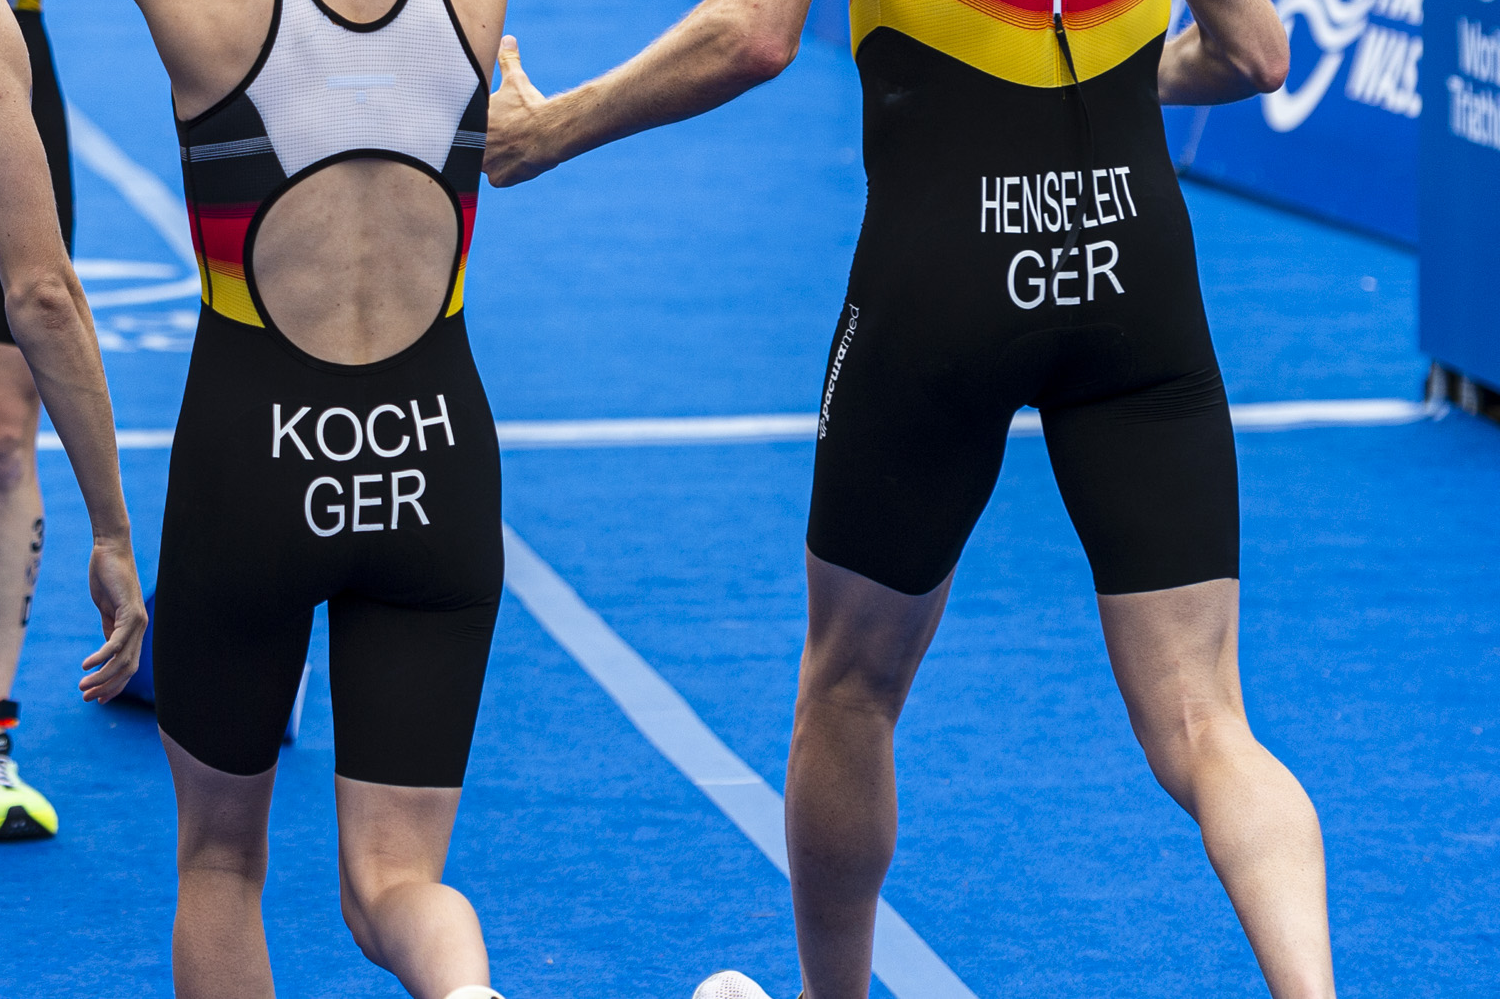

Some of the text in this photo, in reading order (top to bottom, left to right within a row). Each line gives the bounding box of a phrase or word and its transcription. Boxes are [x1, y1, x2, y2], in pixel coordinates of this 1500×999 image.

[1007, 240, 1126, 310] GER
[821, 303, 860, 422] pacuramed
[272, 394, 456, 462] KOCH
[304, 469, 431, 537] GER
